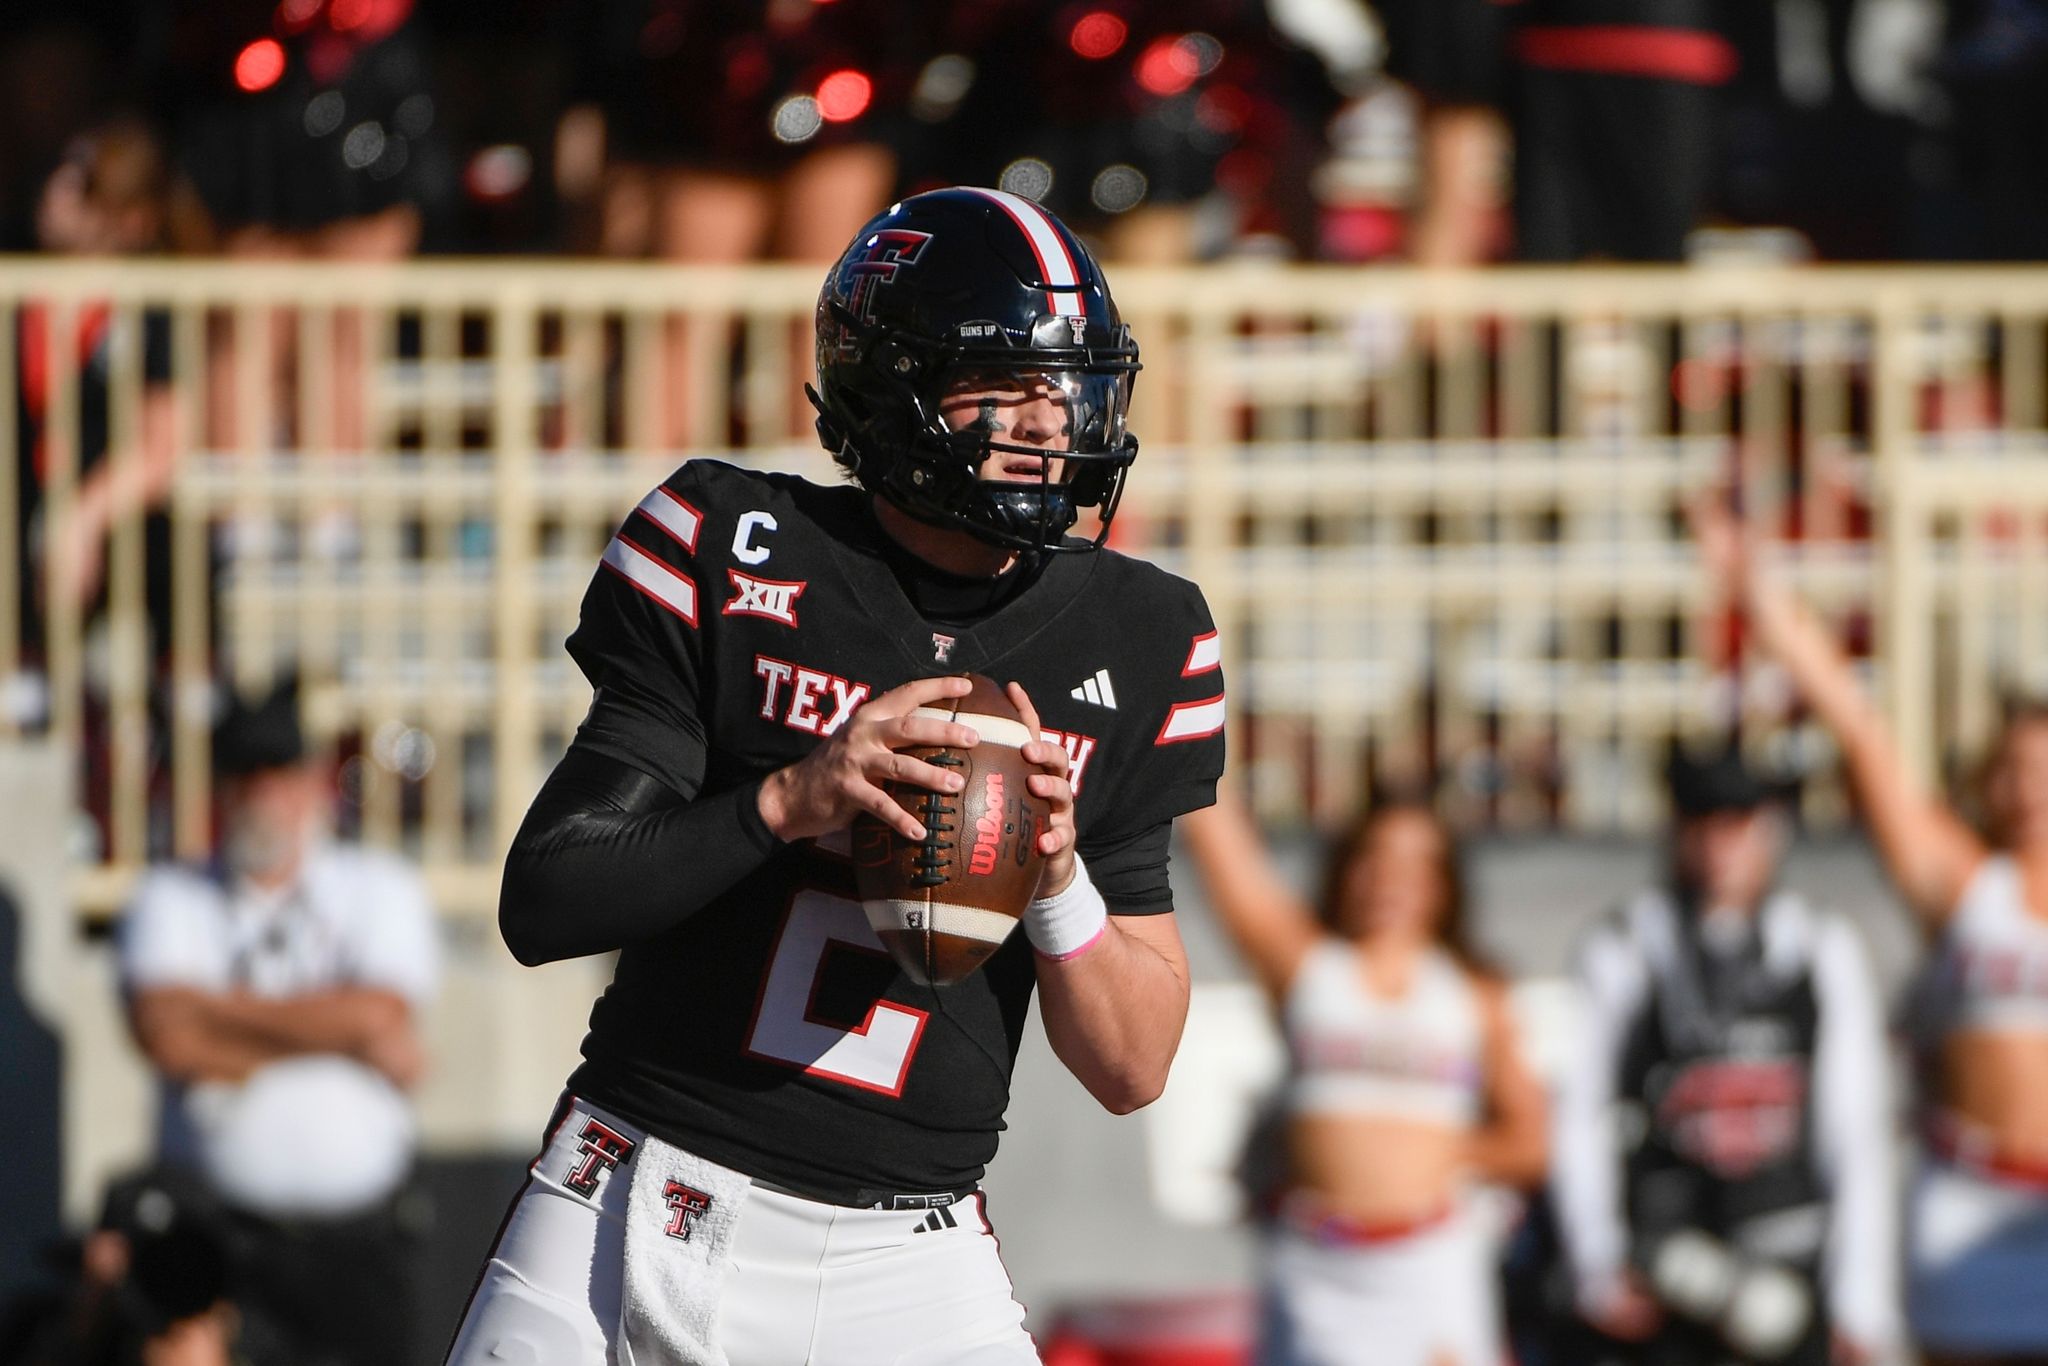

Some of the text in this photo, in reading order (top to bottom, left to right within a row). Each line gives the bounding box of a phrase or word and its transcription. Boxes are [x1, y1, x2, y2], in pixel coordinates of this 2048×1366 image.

[960, 325, 996, 336] GUNS UP
[732, 510, 777, 564] C
[725, 569, 805, 626] XII
[755, 654, 870, 738] TEX
[968, 773, 1004, 876] Wilson
